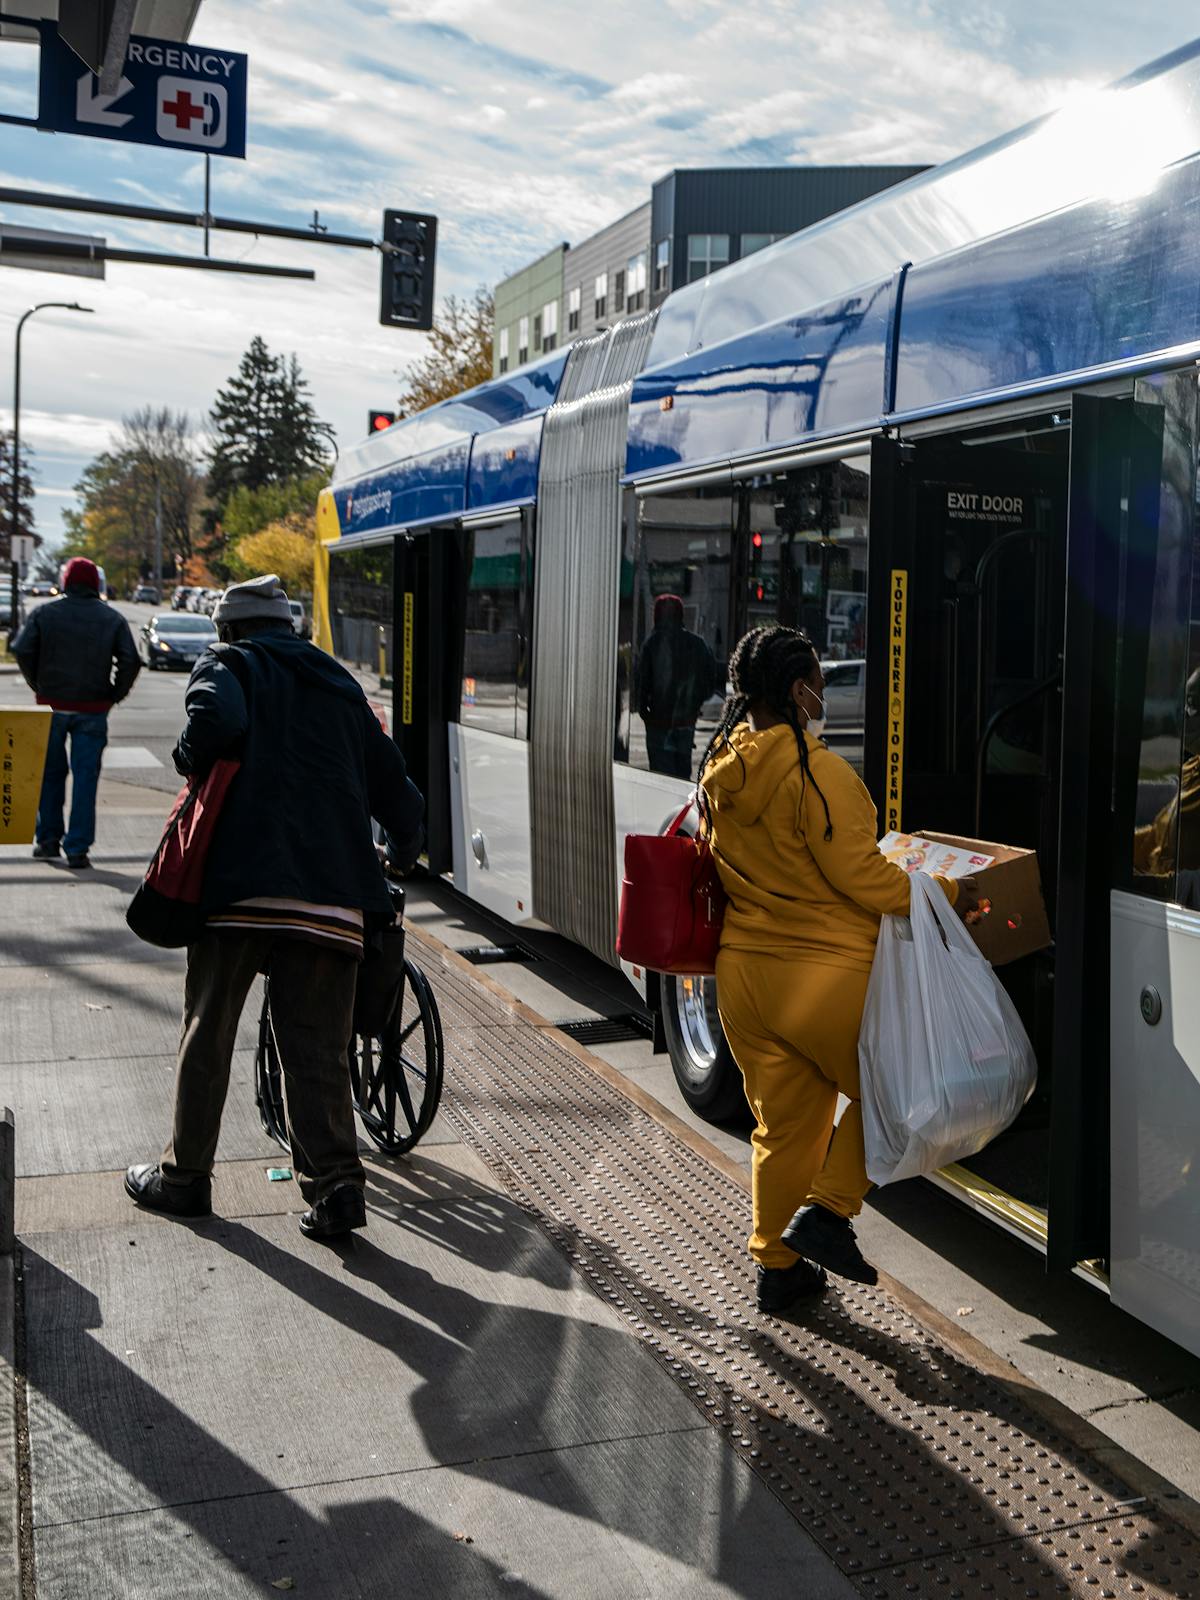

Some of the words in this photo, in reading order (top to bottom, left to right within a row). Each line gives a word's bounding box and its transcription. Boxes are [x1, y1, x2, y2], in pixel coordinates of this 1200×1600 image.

[128, 43, 236, 78] RGENCY
[947, 492, 979, 510] EXIT
[982, 494, 1023, 513] DOOR
[893, 576, 904, 638] TOUCH
[892, 645, 902, 693] HERE
[891, 721, 900, 745] TO
[890, 752, 899, 800] OPEN
[889, 808, 898, 831] DO
